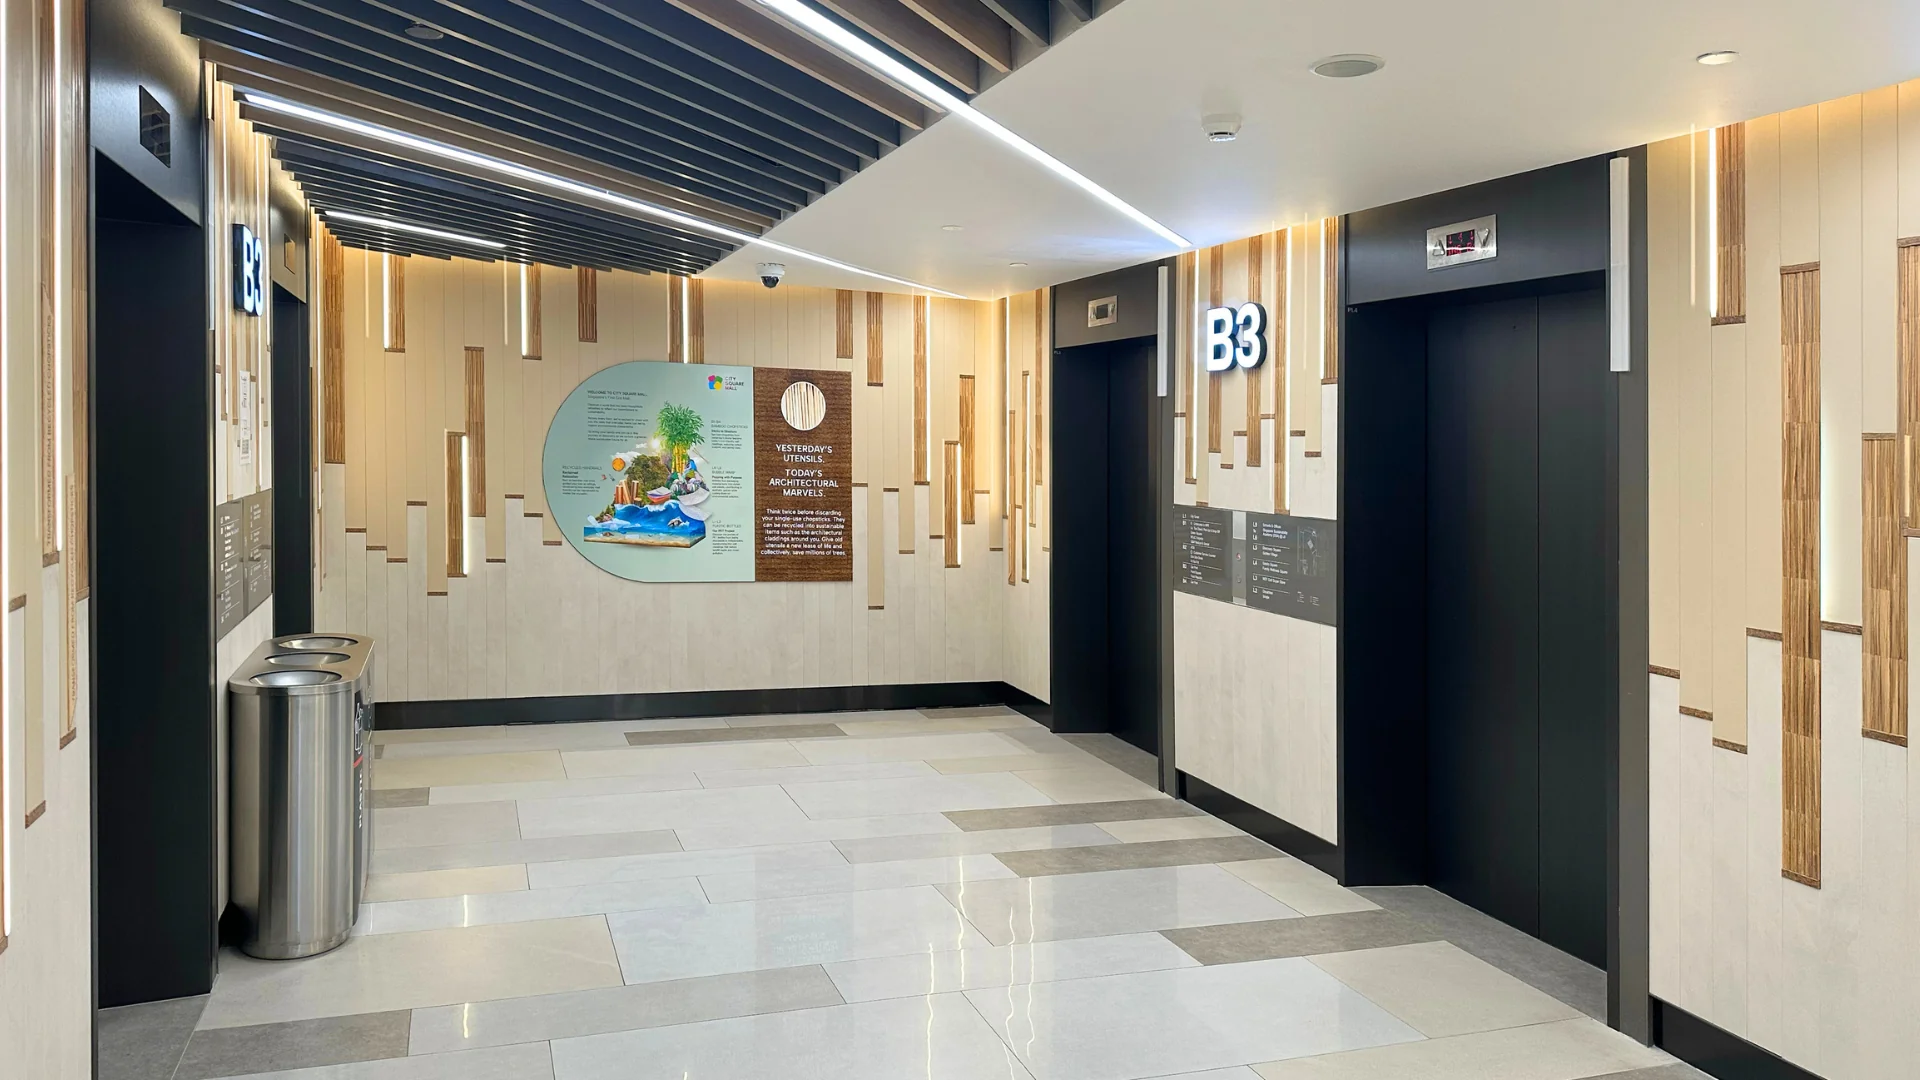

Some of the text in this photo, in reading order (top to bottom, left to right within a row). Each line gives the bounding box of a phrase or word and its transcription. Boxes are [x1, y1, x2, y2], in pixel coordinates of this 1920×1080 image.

[239, 224, 263, 316] B3
[1206, 302, 1264, 371] B3
[776, 444, 833, 454] YESTERDAY'S
[783, 455, 825, 463] UTENSILS.
[785, 469, 823, 477] TODAY'S
[769, 478, 839, 488] ARCHITECTURAL
[783, 489, 826, 497] MARVELS.
[833, 516, 845, 524] They
